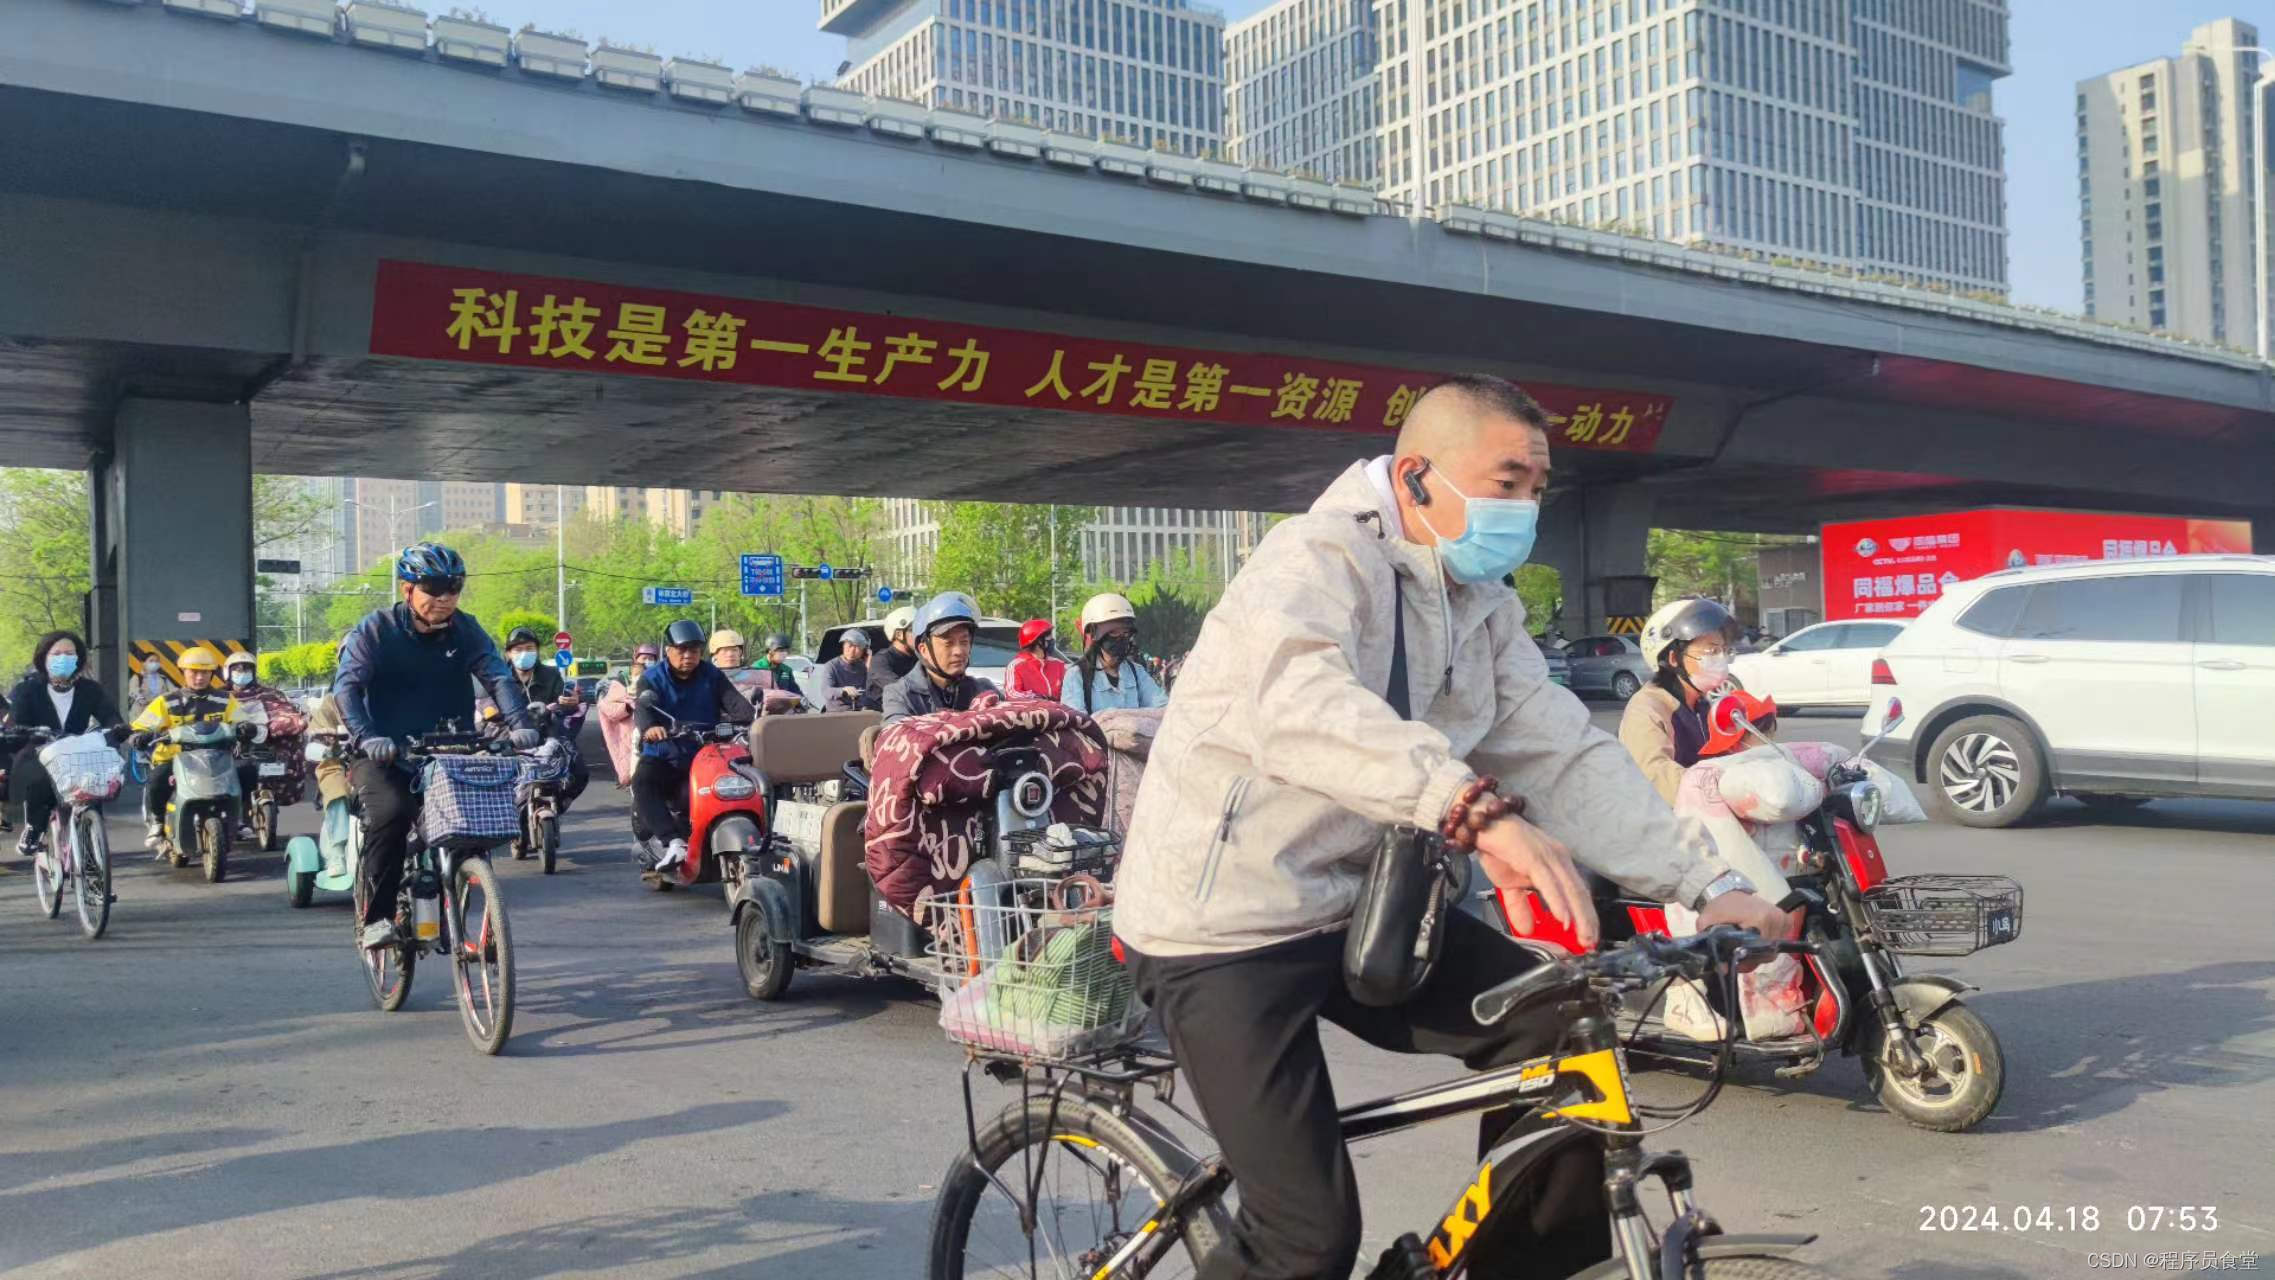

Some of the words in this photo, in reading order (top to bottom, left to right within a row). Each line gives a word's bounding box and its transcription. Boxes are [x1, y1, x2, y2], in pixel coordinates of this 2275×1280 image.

[446, 287, 990, 393] 科技是第一生产力
[1024, 349, 1363, 425] 人才是第一资源
